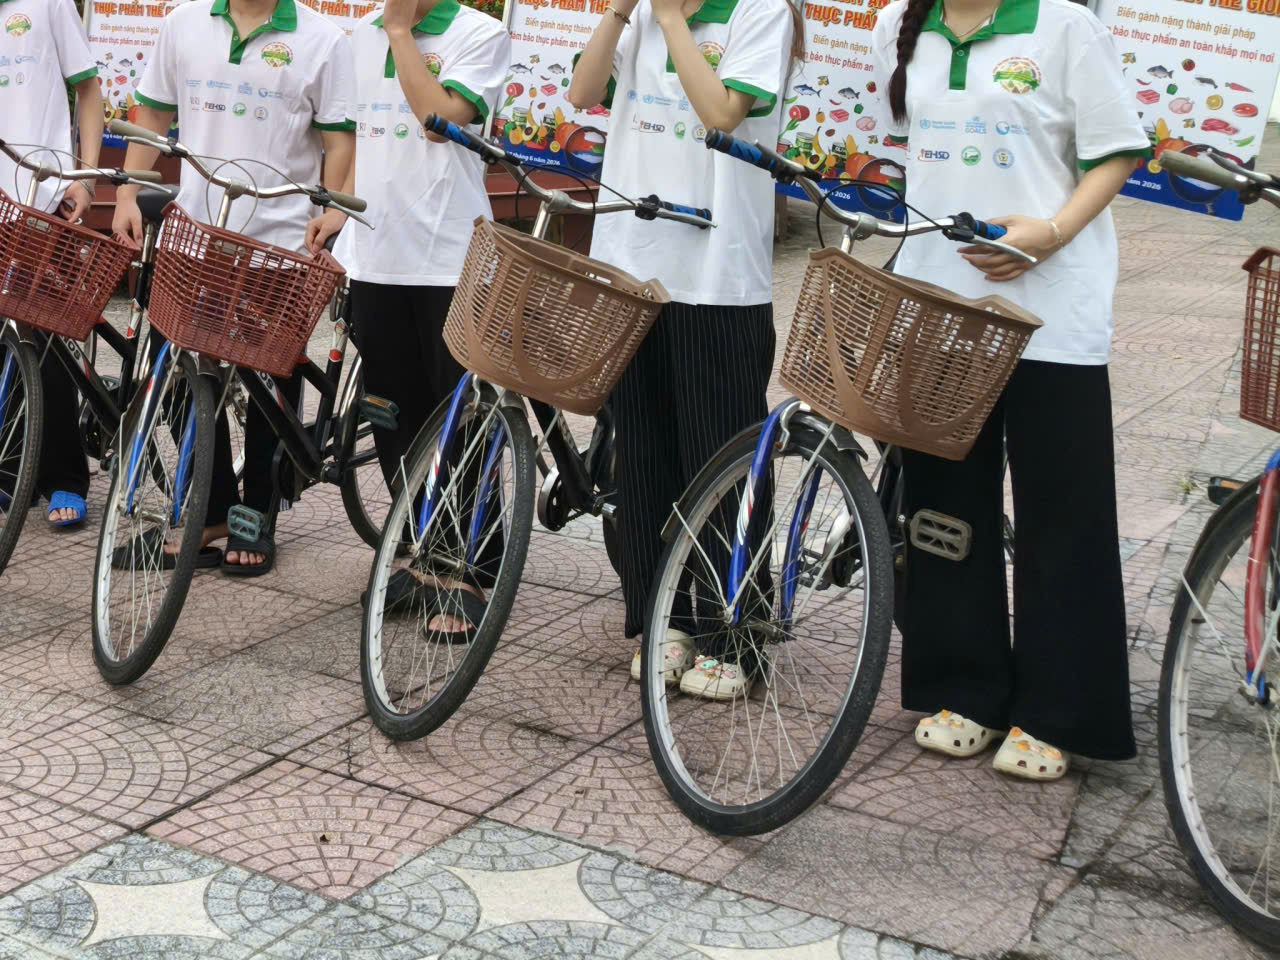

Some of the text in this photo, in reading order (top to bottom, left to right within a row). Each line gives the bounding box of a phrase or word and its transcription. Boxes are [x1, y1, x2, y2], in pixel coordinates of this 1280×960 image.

[93, 1, 118, 18] THỰC
[805, 2, 843, 28] THỰC
[1117, 6, 1256, 41] Biến gánh nặng thành giải pháp
[1113, 25, 1275, 64] bảo thực phẩm an toàn khắp mọi nơi
[834, 190, 851, 200] 2026
[1142, 181, 1162, 191] 2026
